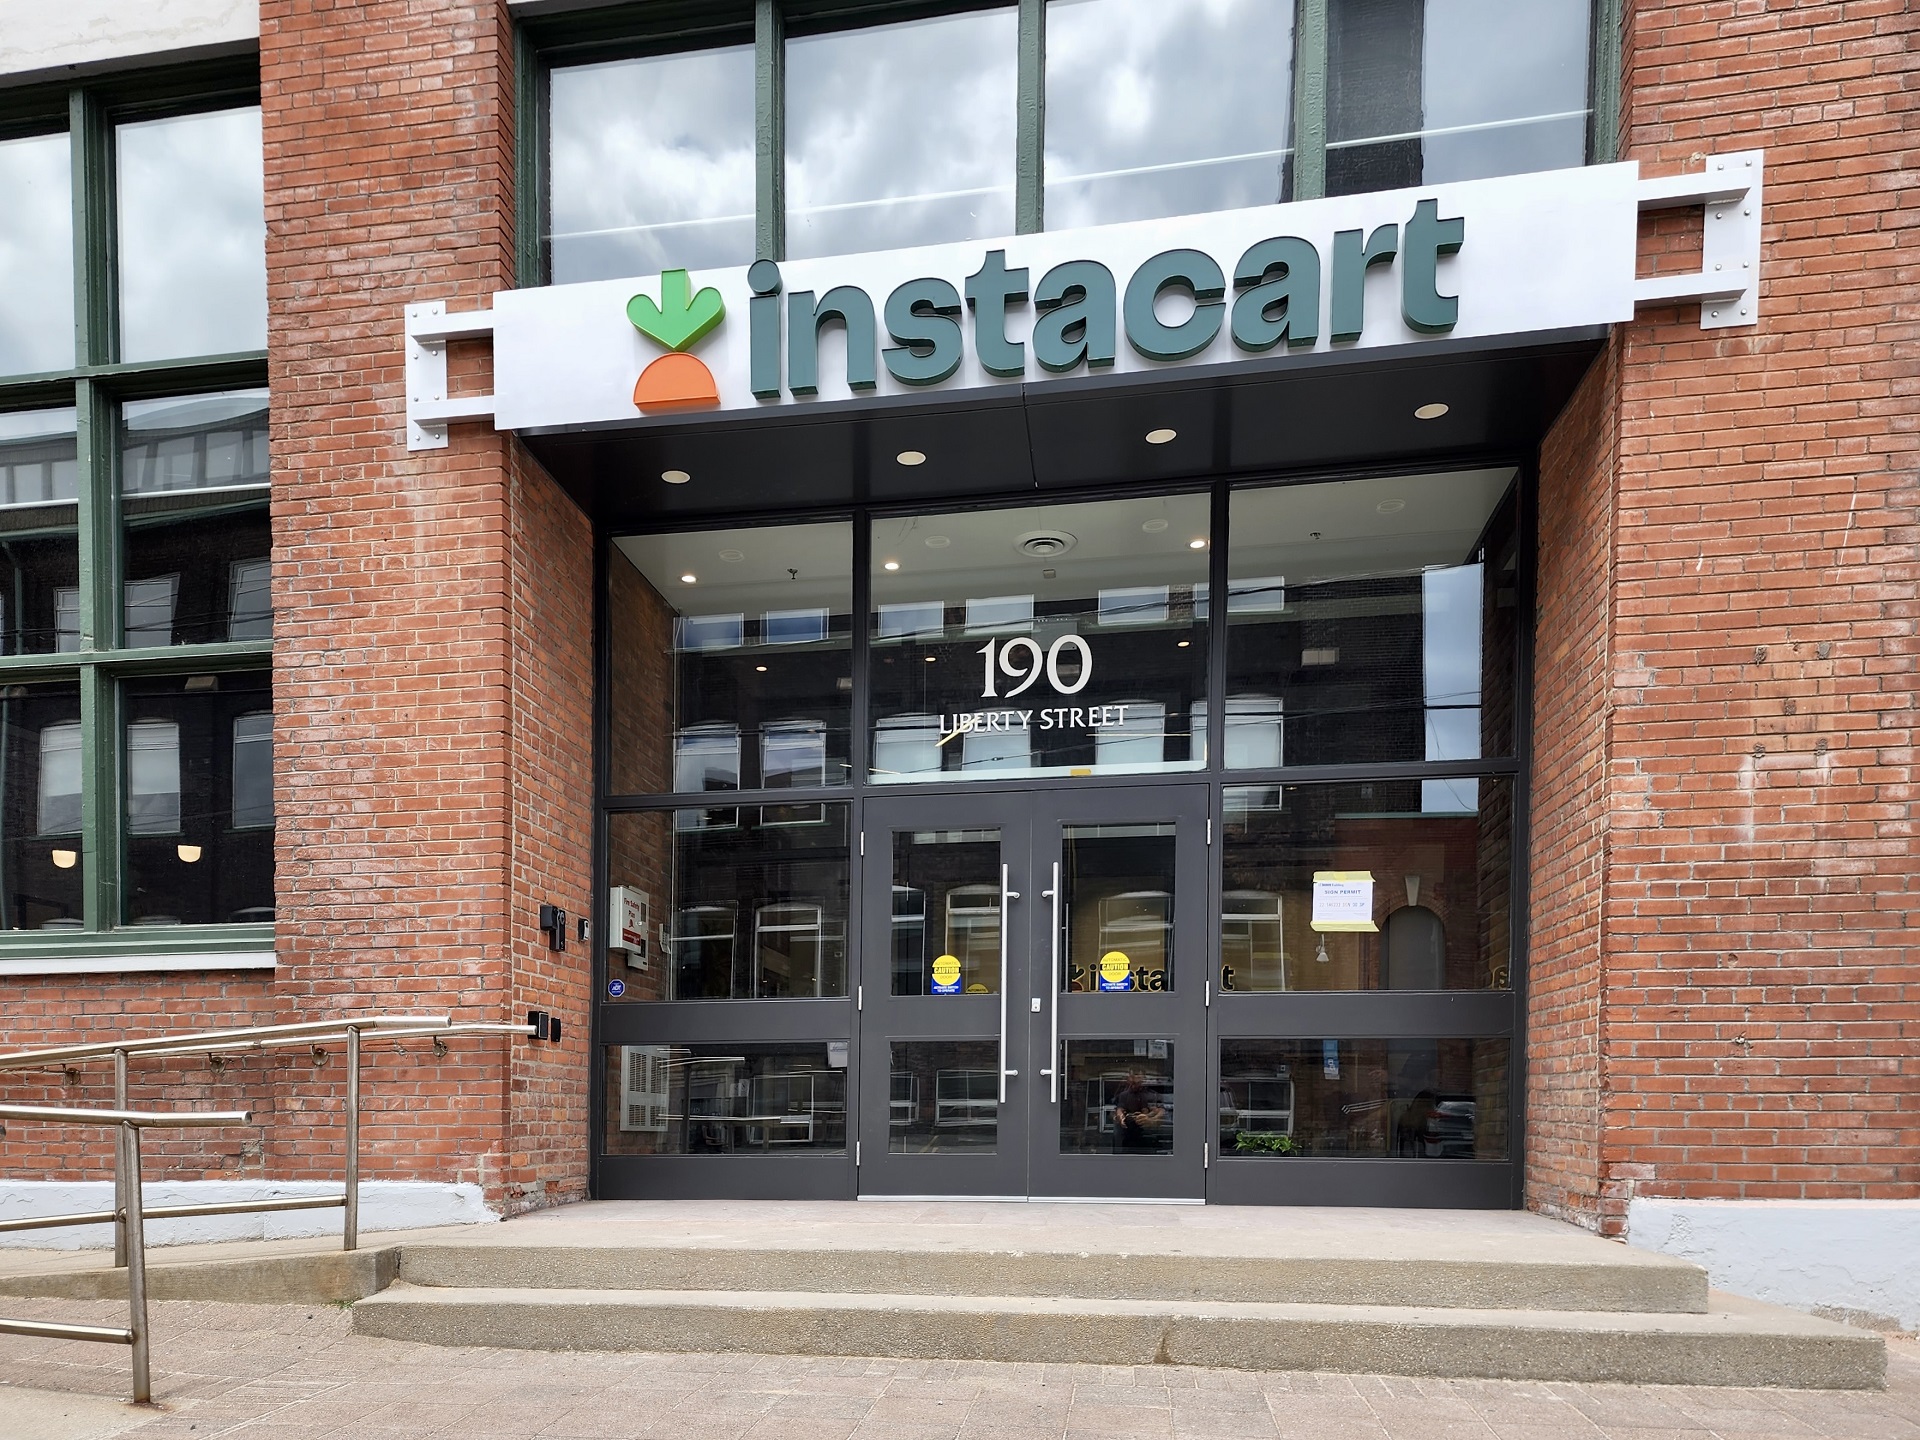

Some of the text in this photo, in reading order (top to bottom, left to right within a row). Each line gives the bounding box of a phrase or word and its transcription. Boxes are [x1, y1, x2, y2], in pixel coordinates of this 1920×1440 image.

[748, 199, 1464, 399] instacart
[976, 634, 1092, 698] 190
[940, 705, 1129, 734] LIBERTY STREET
